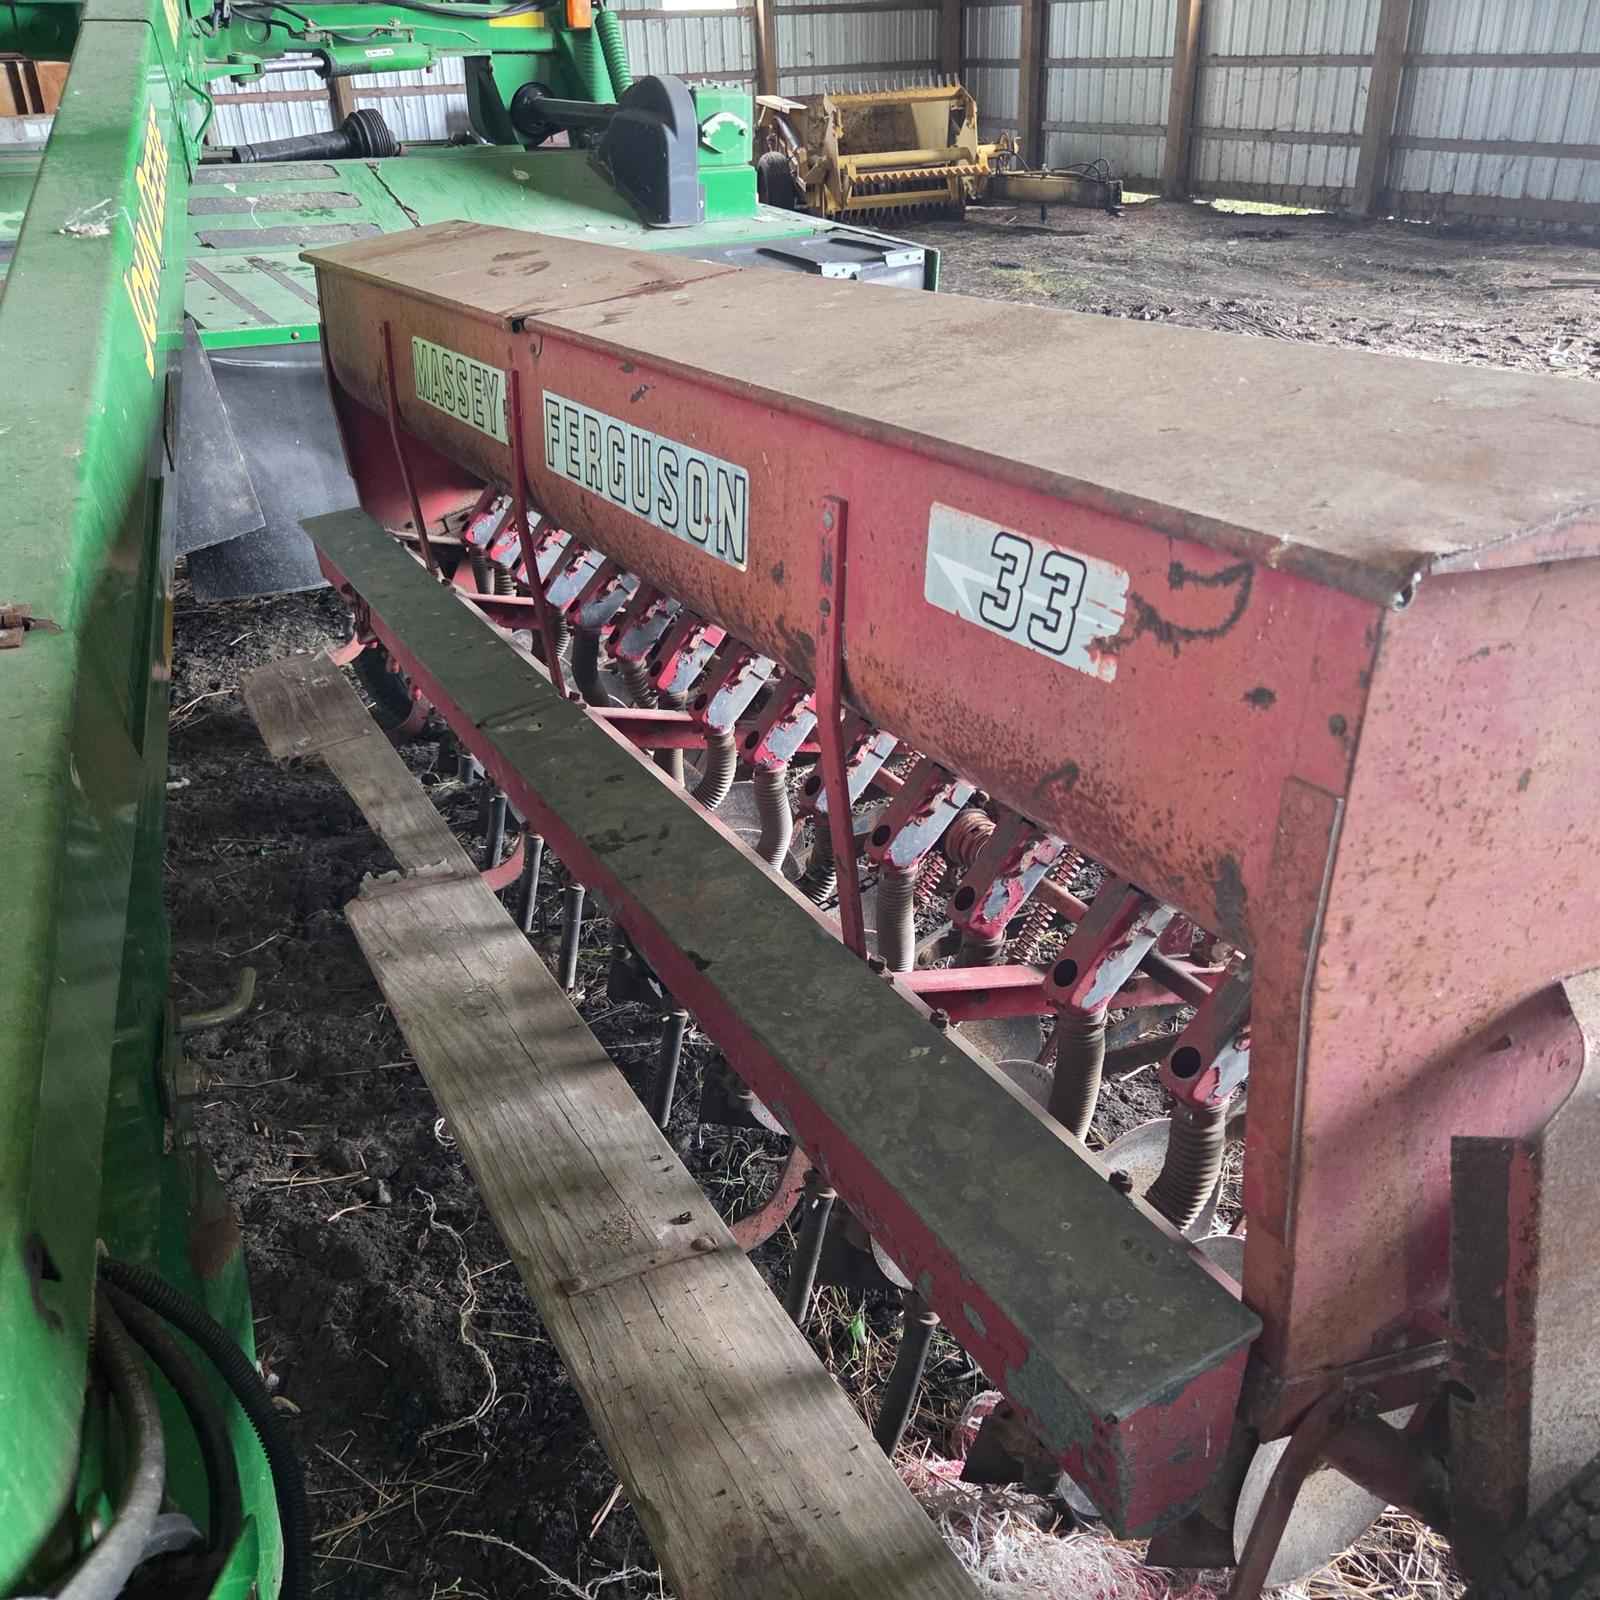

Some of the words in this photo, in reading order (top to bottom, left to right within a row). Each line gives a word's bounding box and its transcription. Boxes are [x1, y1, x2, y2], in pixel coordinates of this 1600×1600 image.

[136, 104, 168, 254] DEERE
[124, 206, 161, 379] JOHN
[413, 341, 499, 434] MASSEY
[545, 398, 746, 562] FERGUSON
[979, 531, 1087, 655] 33
